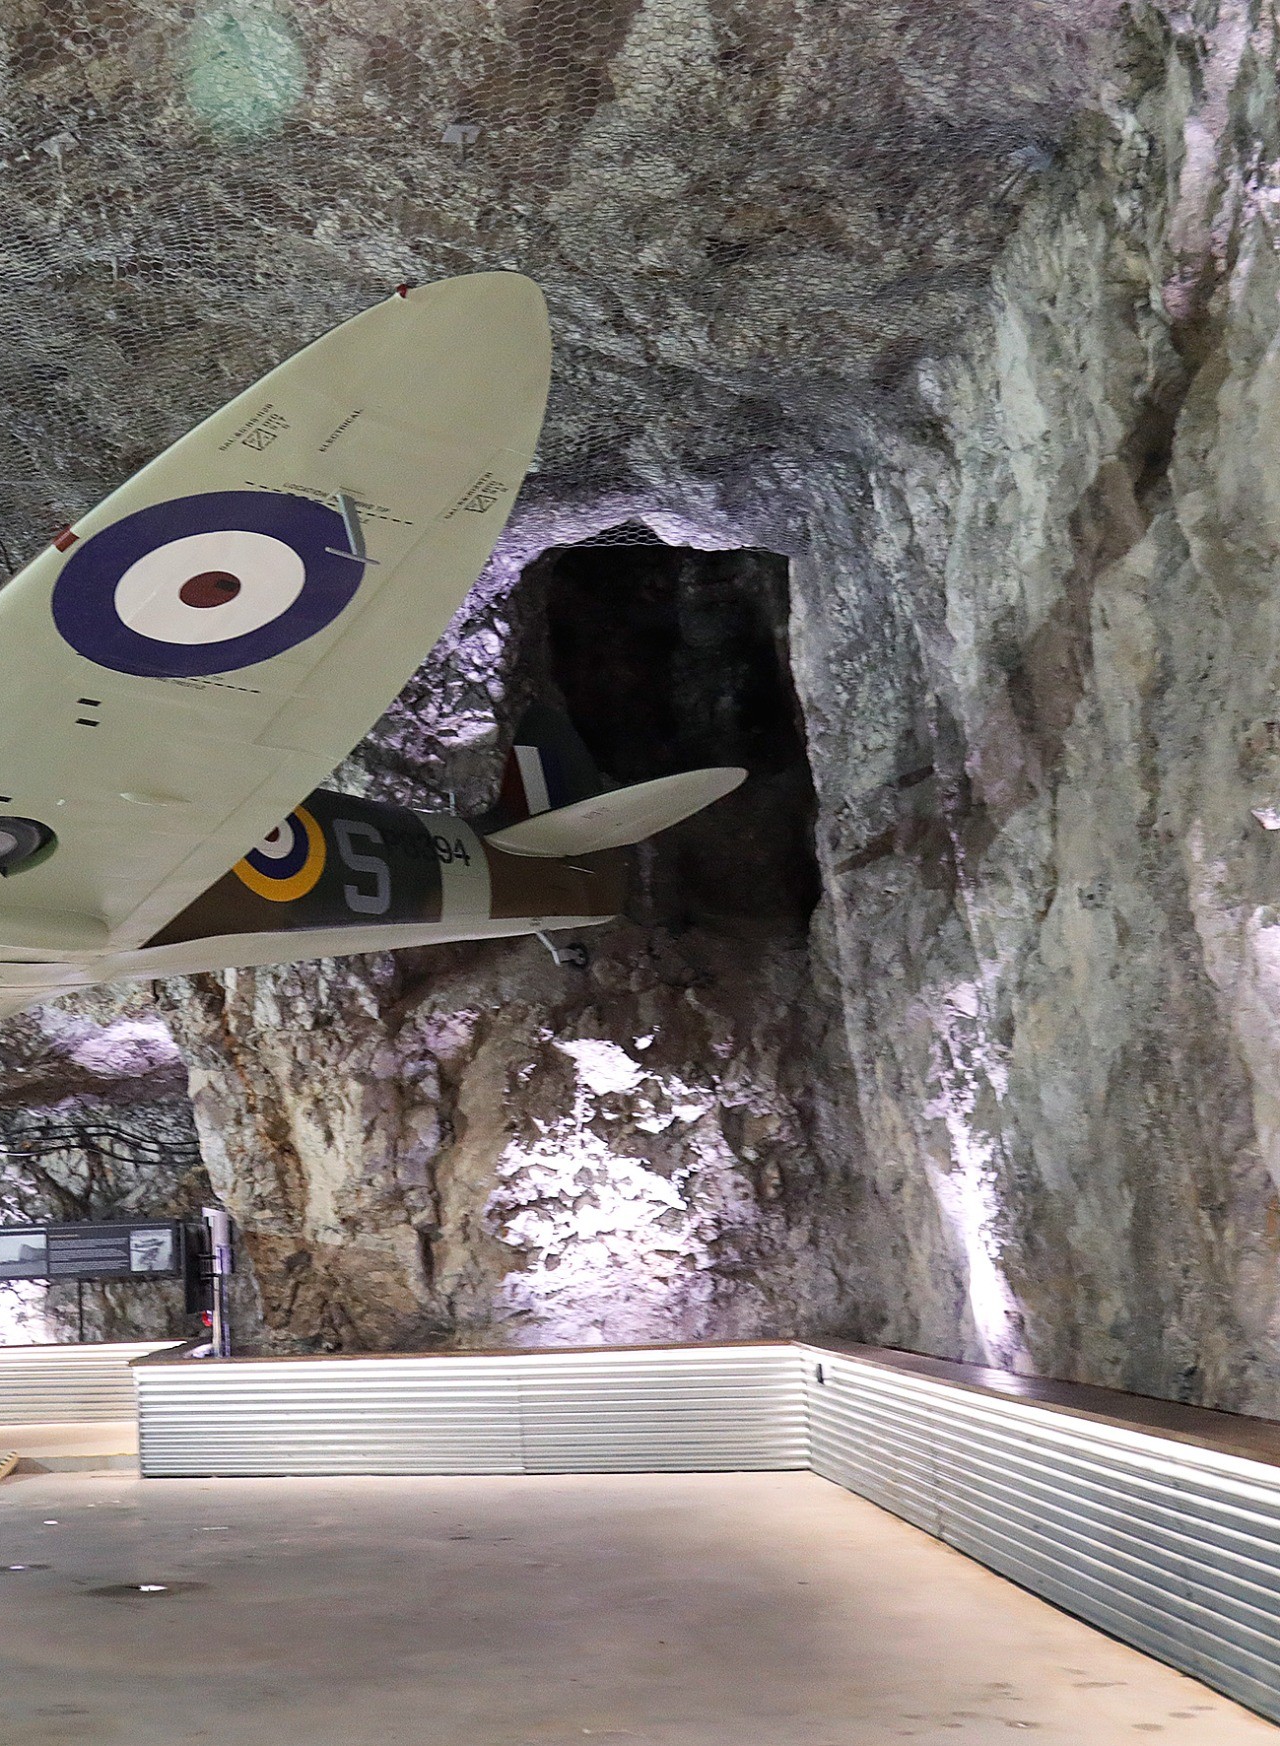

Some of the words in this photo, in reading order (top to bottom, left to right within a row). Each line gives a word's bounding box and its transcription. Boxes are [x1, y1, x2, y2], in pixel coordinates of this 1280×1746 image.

[318, 409, 365, 453] ELECTRICAL
[283, 483, 330, 498] LOCATION
[332, 818, 392, 915] S
